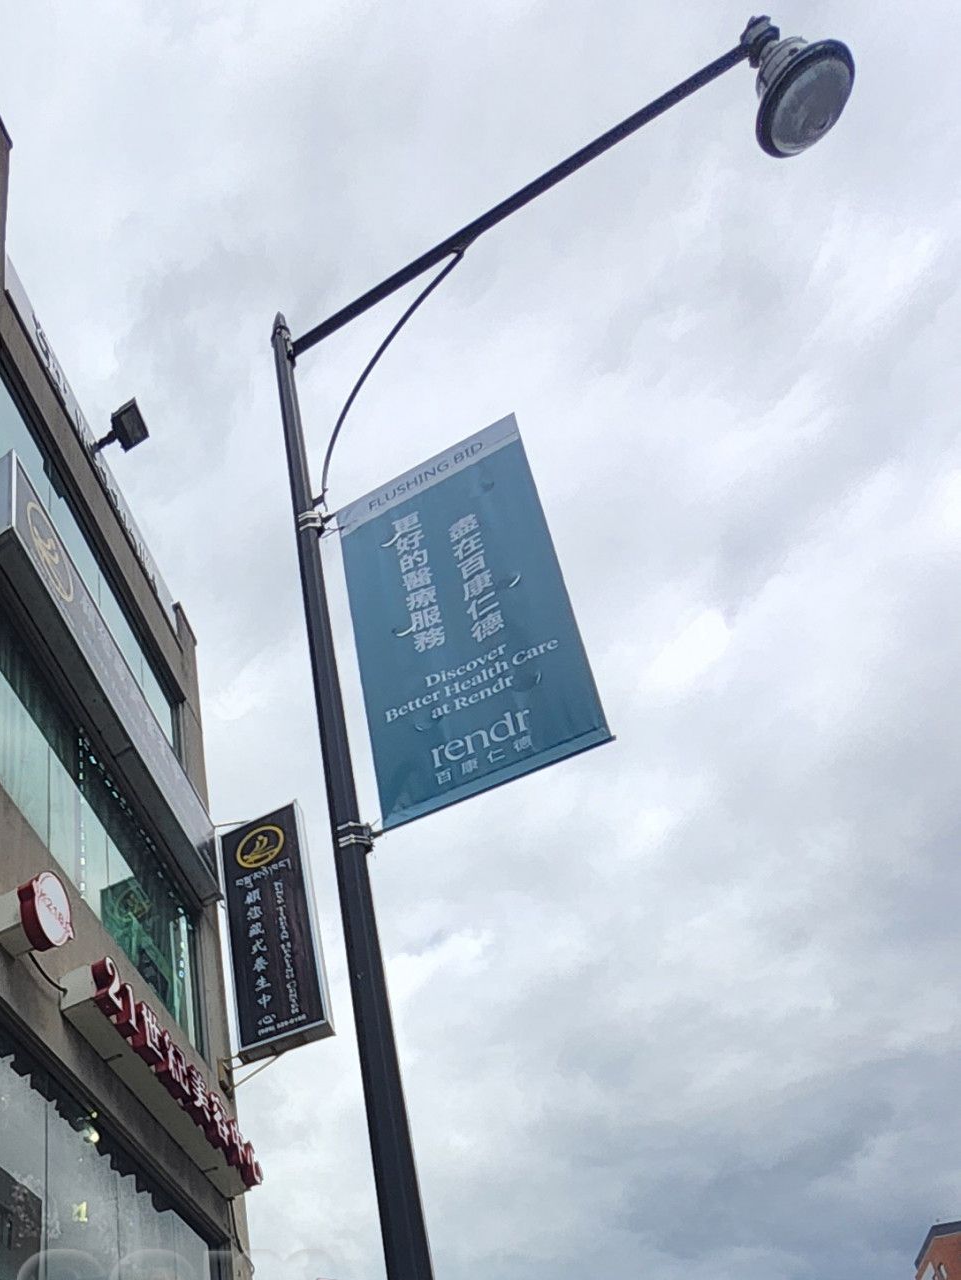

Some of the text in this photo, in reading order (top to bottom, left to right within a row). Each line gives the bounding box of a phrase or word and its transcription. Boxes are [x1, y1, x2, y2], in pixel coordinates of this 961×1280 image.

[367, 441, 483, 512] FLUSHING BID
[391, 511, 445, 654] 更好的醫療服務
[448, 512, 505, 644] 盡在百康仁德
[384, 638, 559, 724] Better Health Care
[424, 643, 507, 688] Discover
[431, 674, 515, 720] at Rendr
[430, 707, 532, 768] rendr
